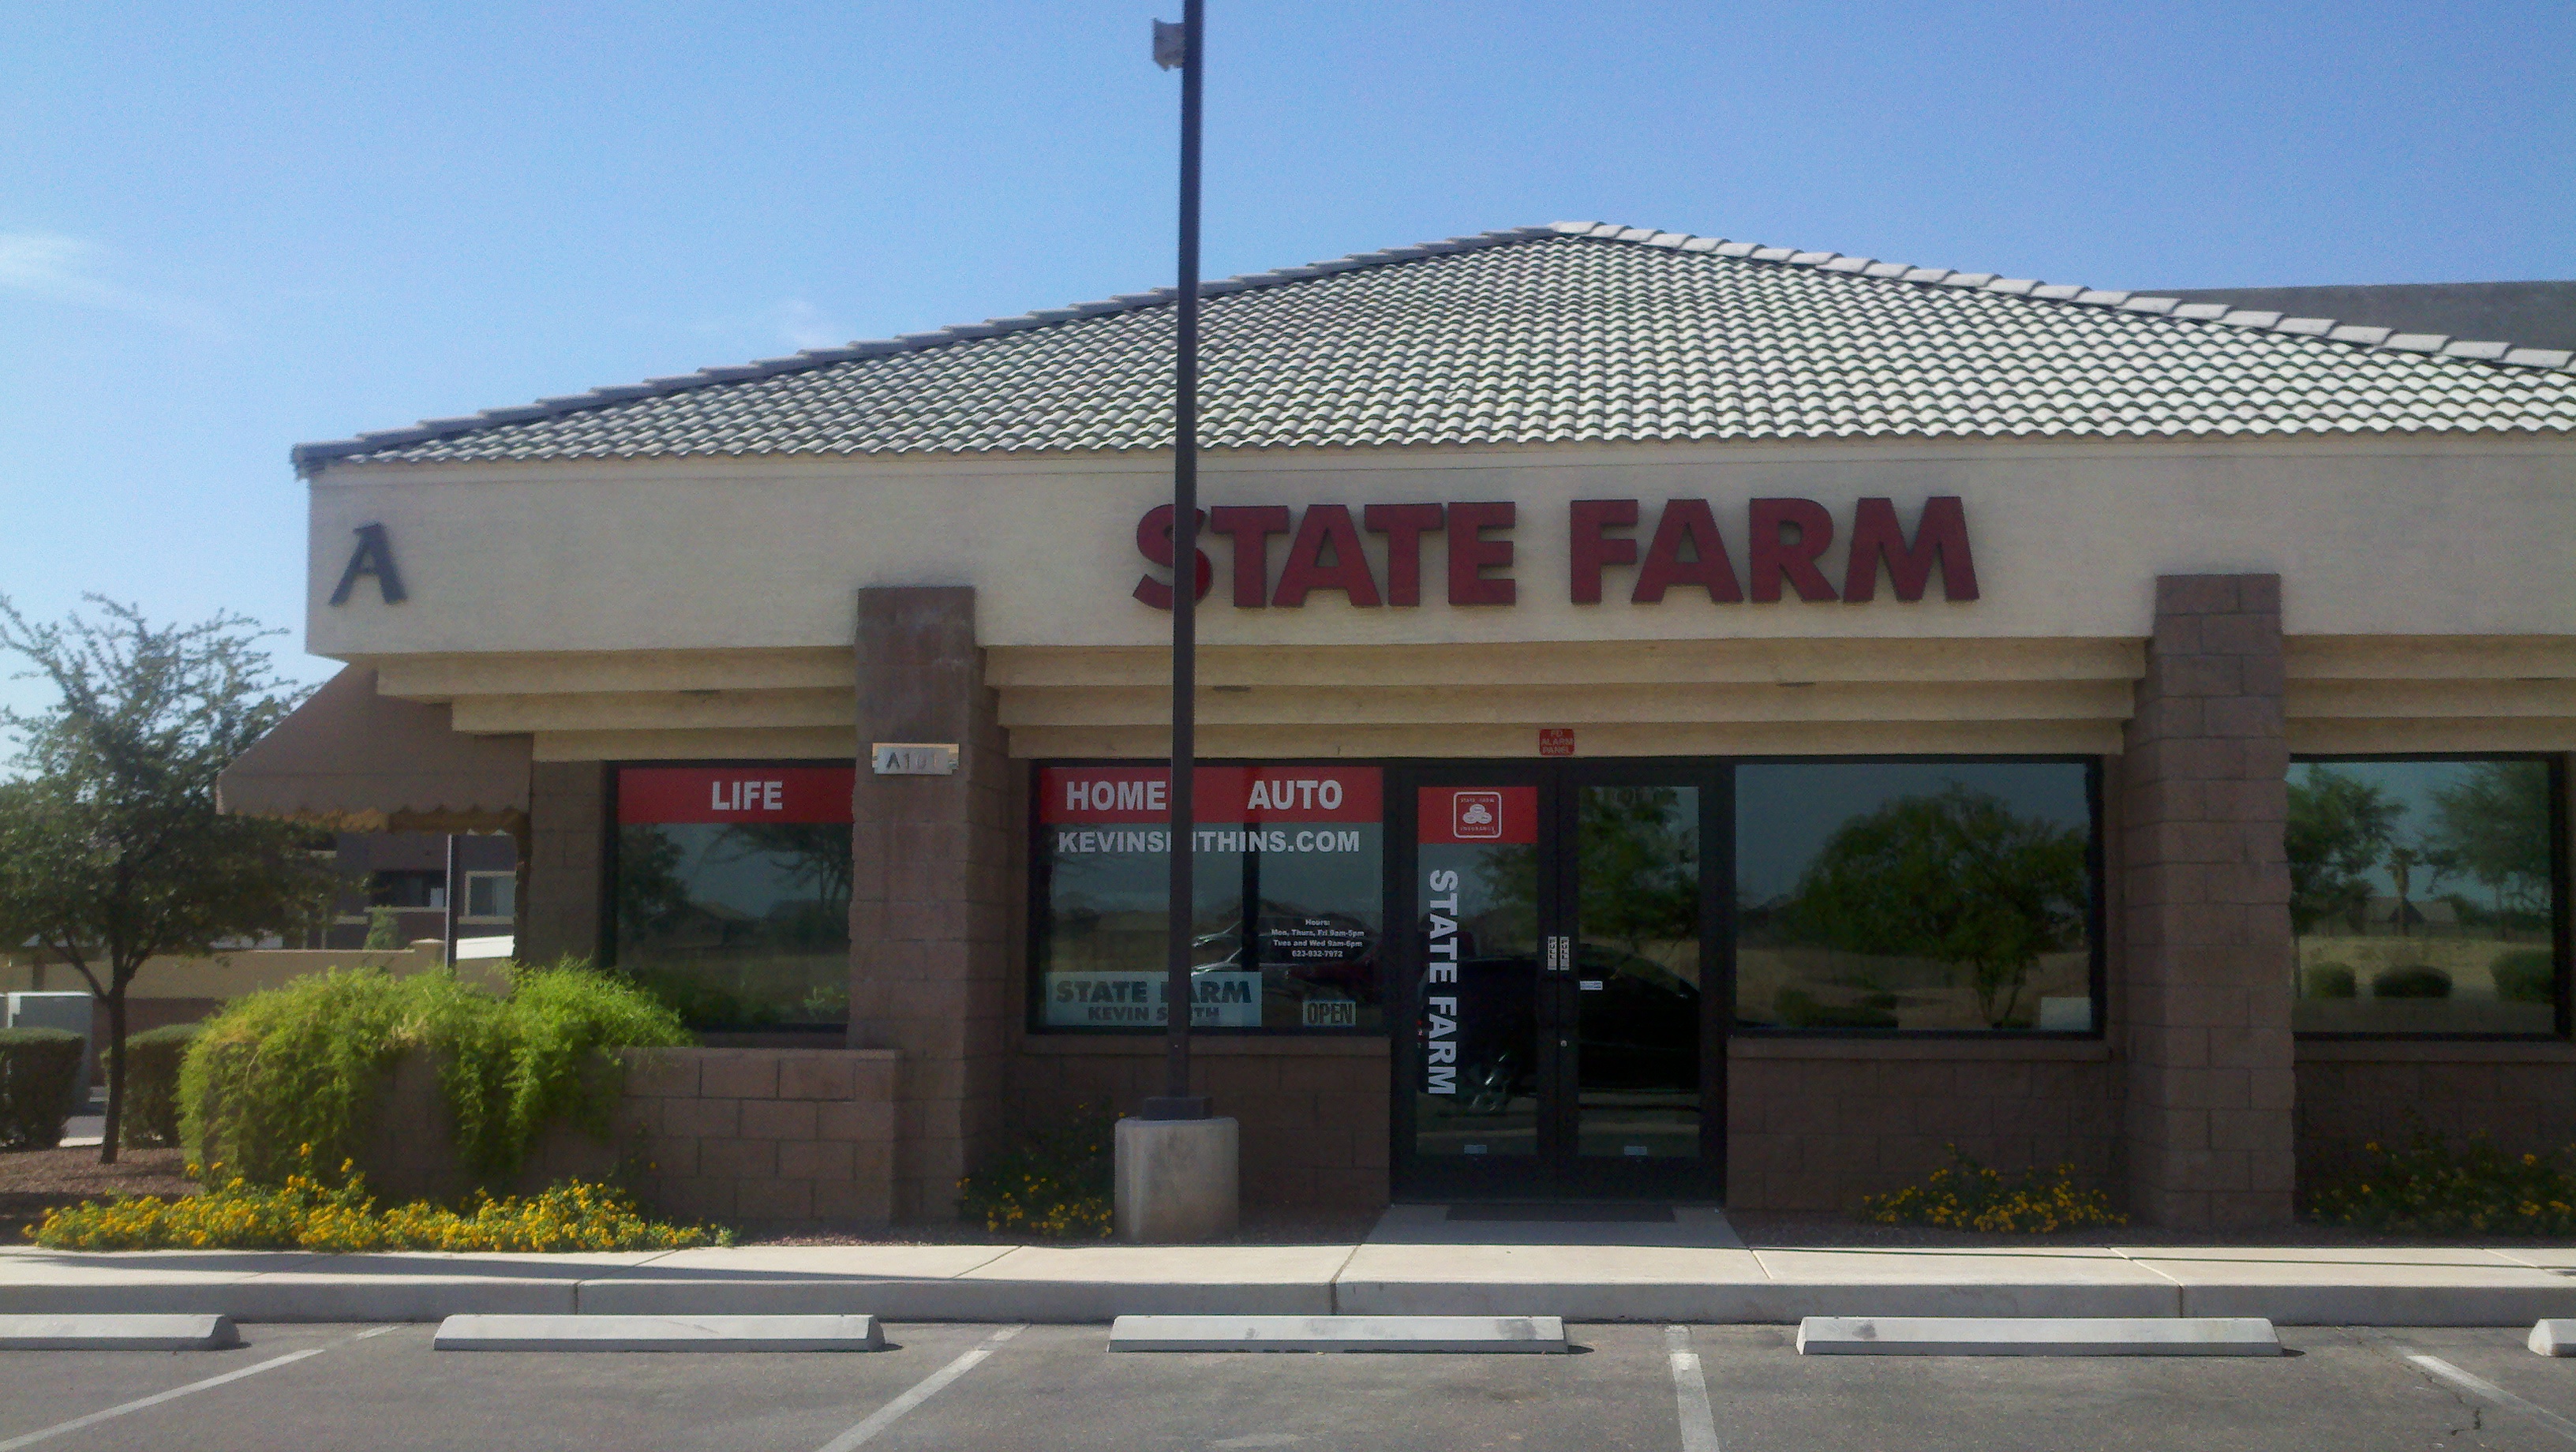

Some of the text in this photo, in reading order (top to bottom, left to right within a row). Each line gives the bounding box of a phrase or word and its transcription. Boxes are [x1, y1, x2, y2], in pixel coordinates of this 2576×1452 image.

[328, 521, 408, 606] A
[1133, 496, 1979, 610] STATE FARM
[712, 781, 783, 810] LIFE
[1066, 780, 1343, 810] HOME AUTO
[1271, 929, 1290, 937] Mon,
[1291, 929, 1316, 937] Thurs,
[1056, 980, 1148, 1004] STATE
[1428, 869, 1458, 1095] STATE FARM
[1088, 1007, 1220, 1021] KEVIN STH
[1307, 1003, 1353, 1024] OPEN
